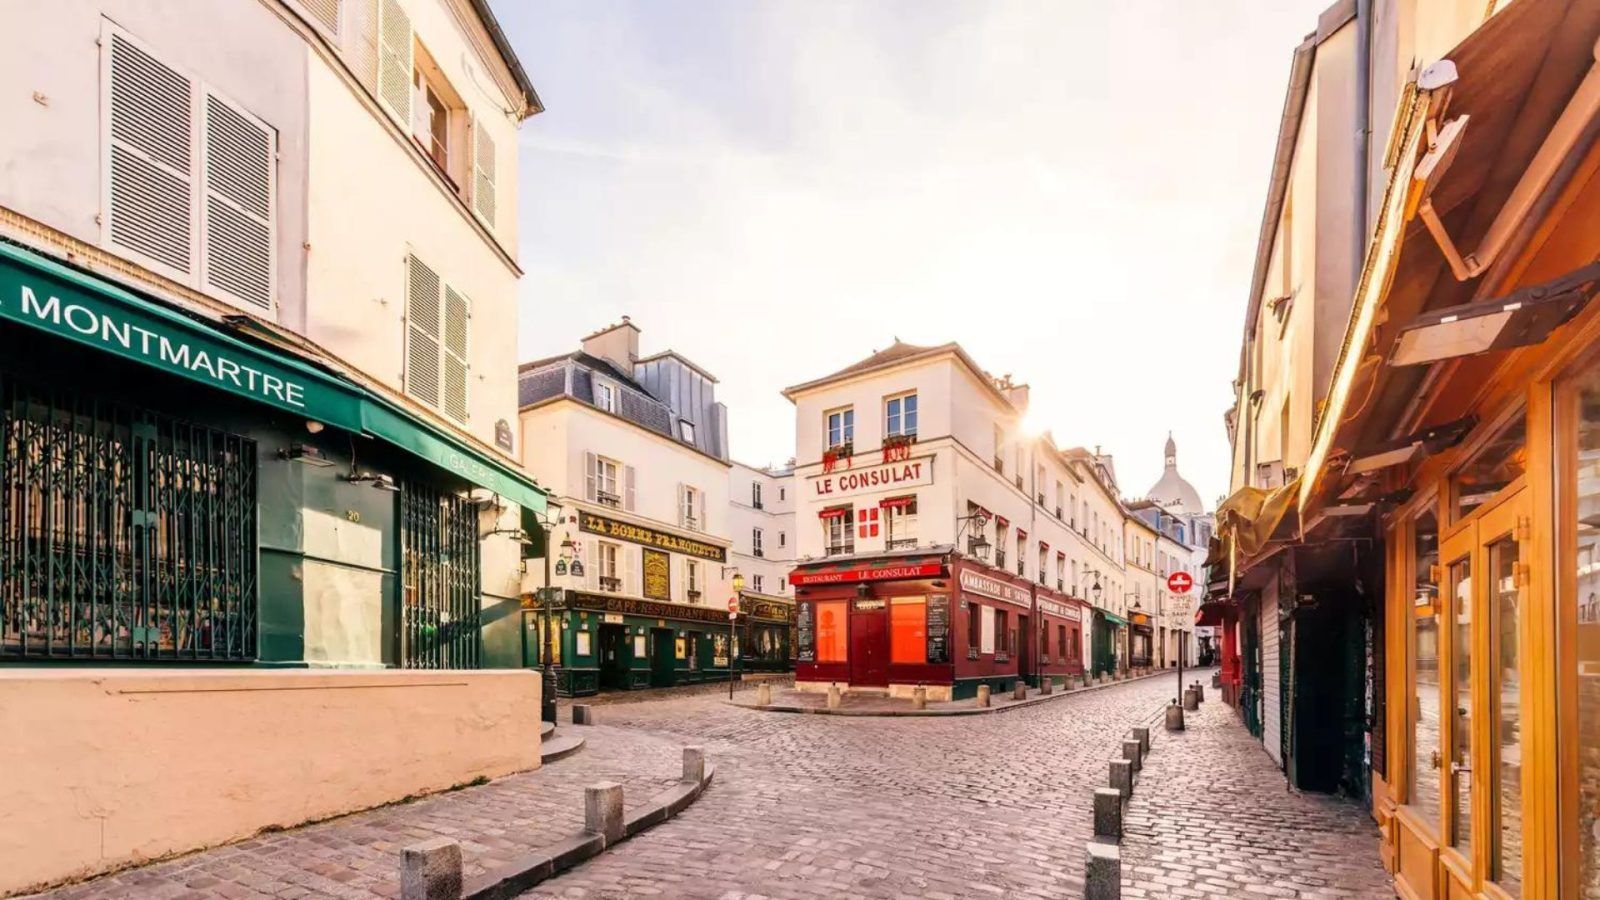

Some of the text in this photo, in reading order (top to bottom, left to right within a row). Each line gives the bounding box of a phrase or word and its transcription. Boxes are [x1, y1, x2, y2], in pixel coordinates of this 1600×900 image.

[21, 285, 305, 407] MONTMARTRE
[816, 463, 921, 495] LE CONSULAT
[348, 510, 360, 521] 20
[588, 516, 606, 533] LA
[611, 522, 652, 543] BONNE
[803, 566, 922, 583] RESTAURANT LE CONSULAT
[964, 574, 1001, 595] AMBASSADE
